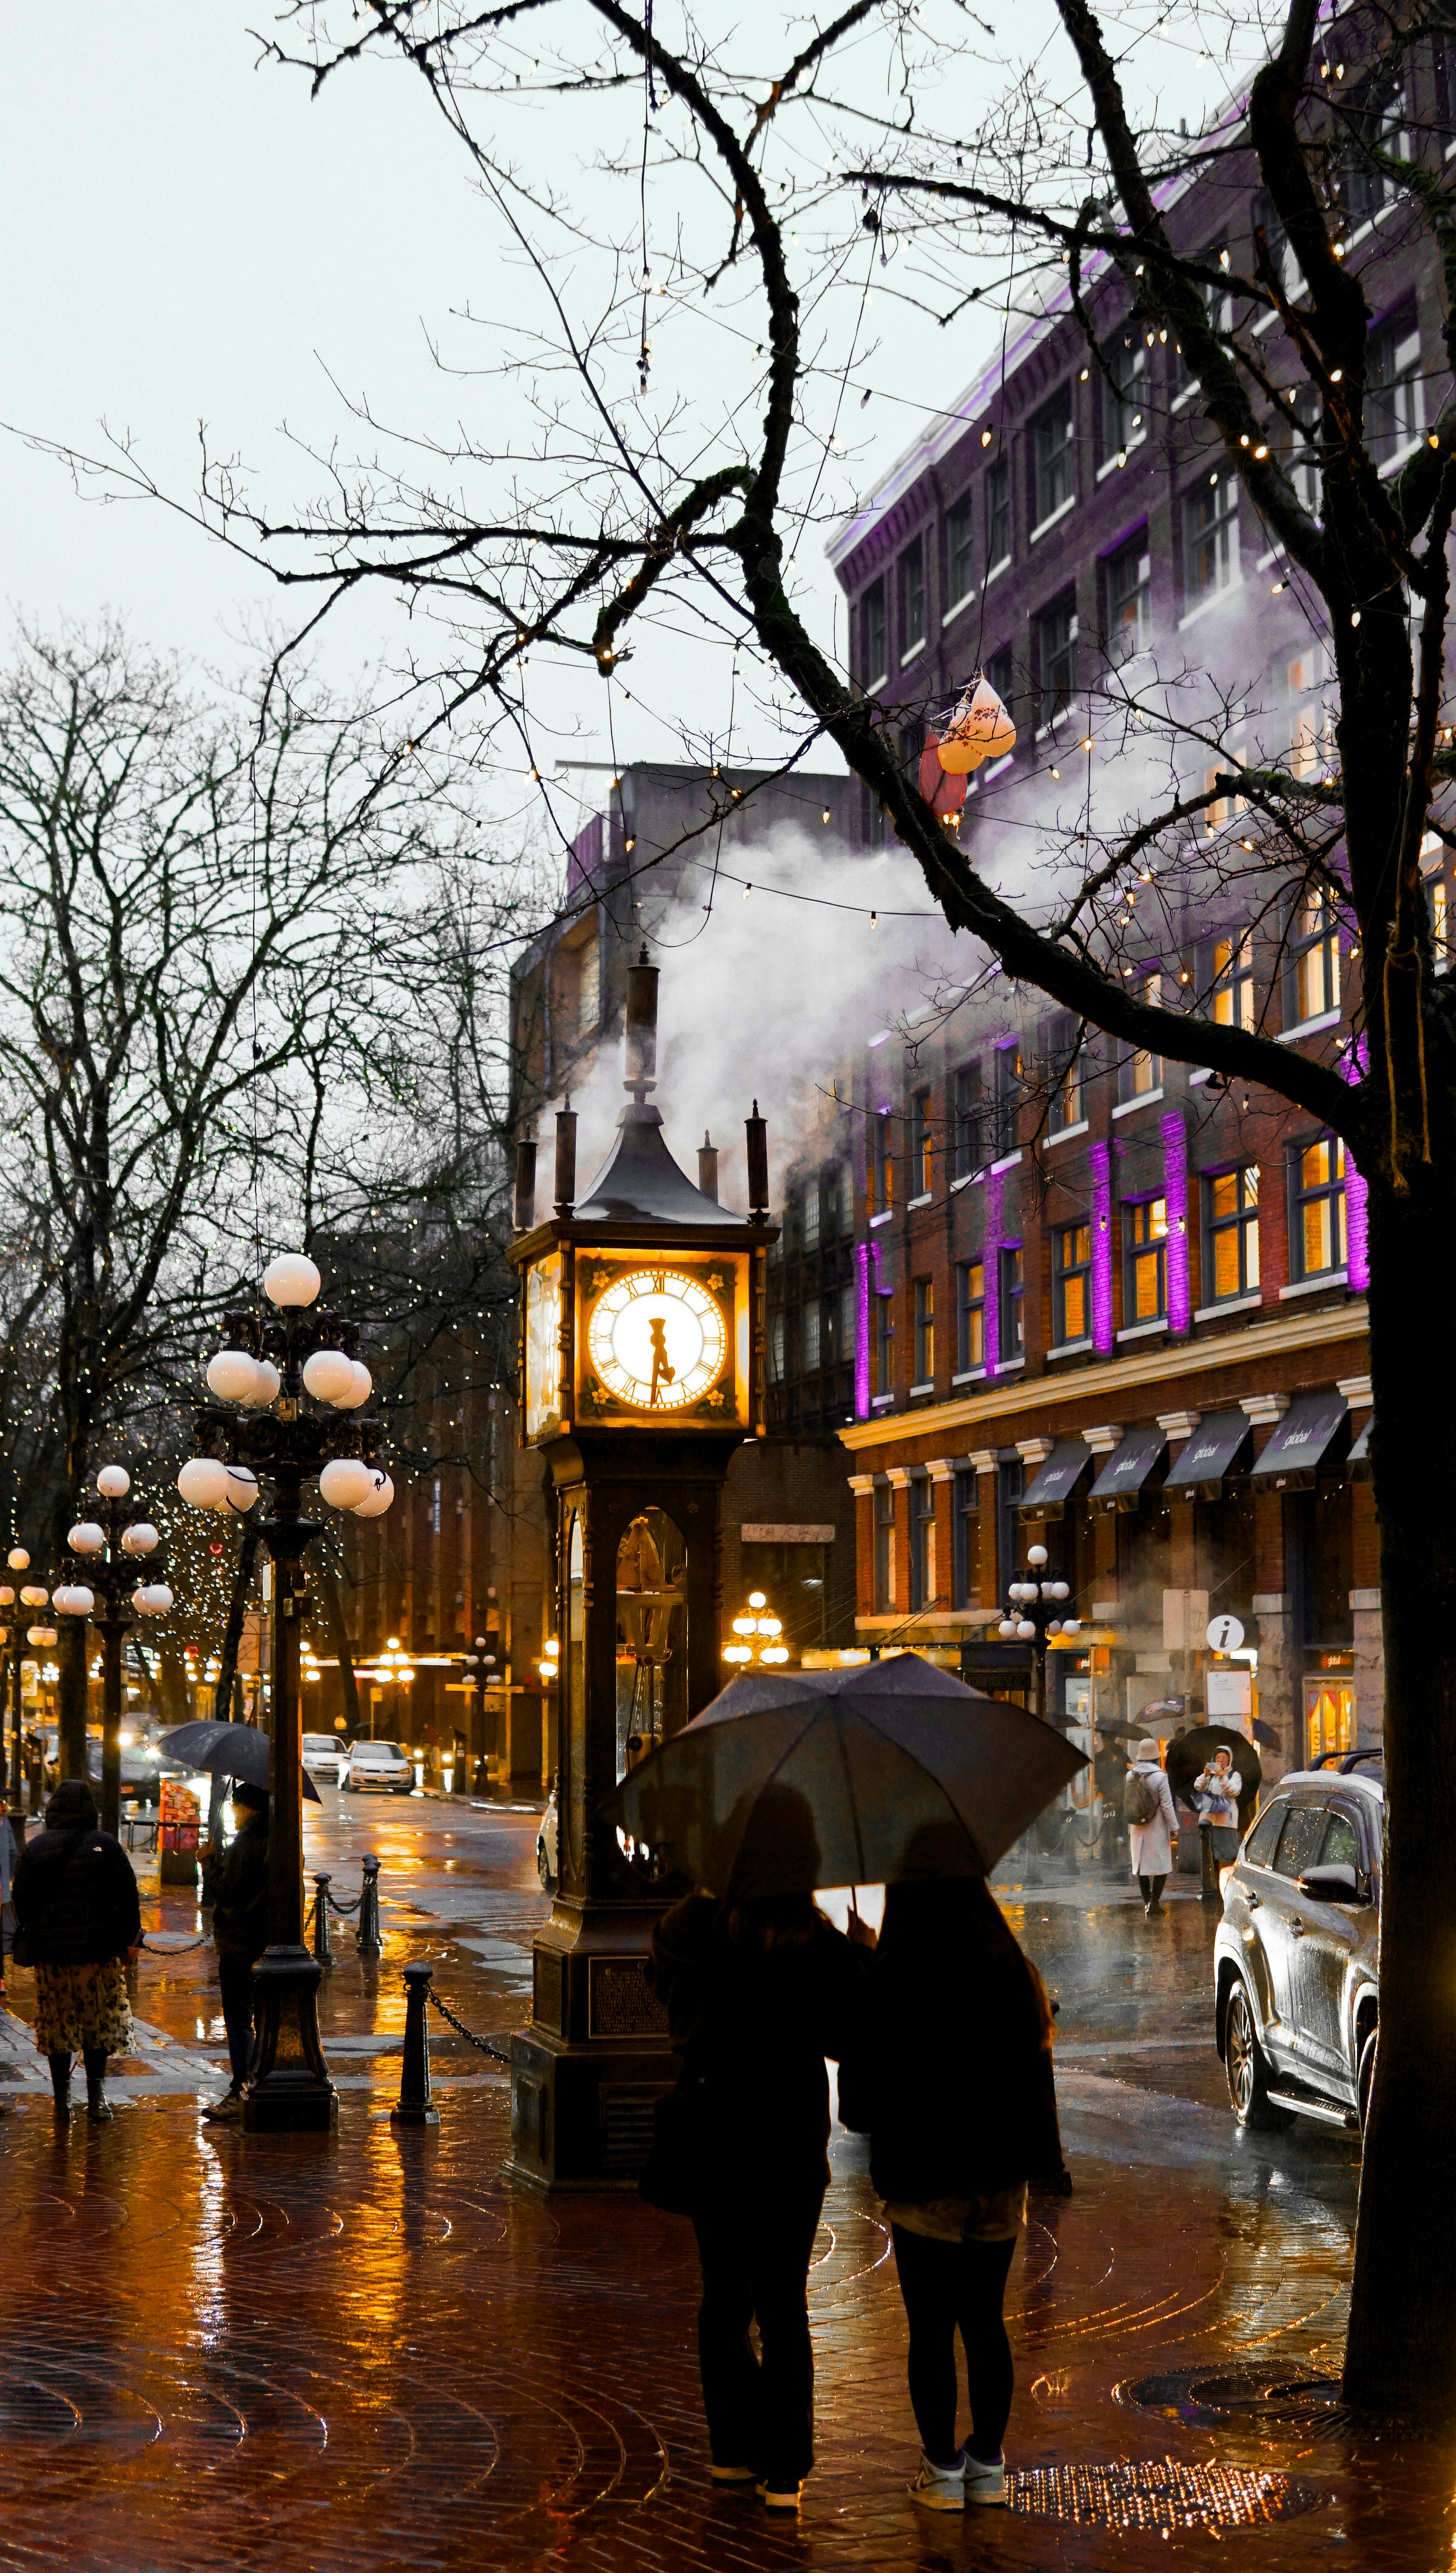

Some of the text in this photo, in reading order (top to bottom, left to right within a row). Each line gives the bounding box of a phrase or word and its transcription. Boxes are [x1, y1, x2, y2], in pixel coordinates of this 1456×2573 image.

[623, 1282, 639, 1300] XI
[652, 1276, 665, 1293] XII
[1282, 1429, 1313, 1450] global
[1191, 1442, 1220, 1463] global
[1114, 1458, 1139, 1476] global
[1043, 1467, 1067, 1486] global
[1276, 1478, 1286, 1489] global
[1219, 1621, 1230, 1648] i
[1327, 1655, 1341, 1668] global
